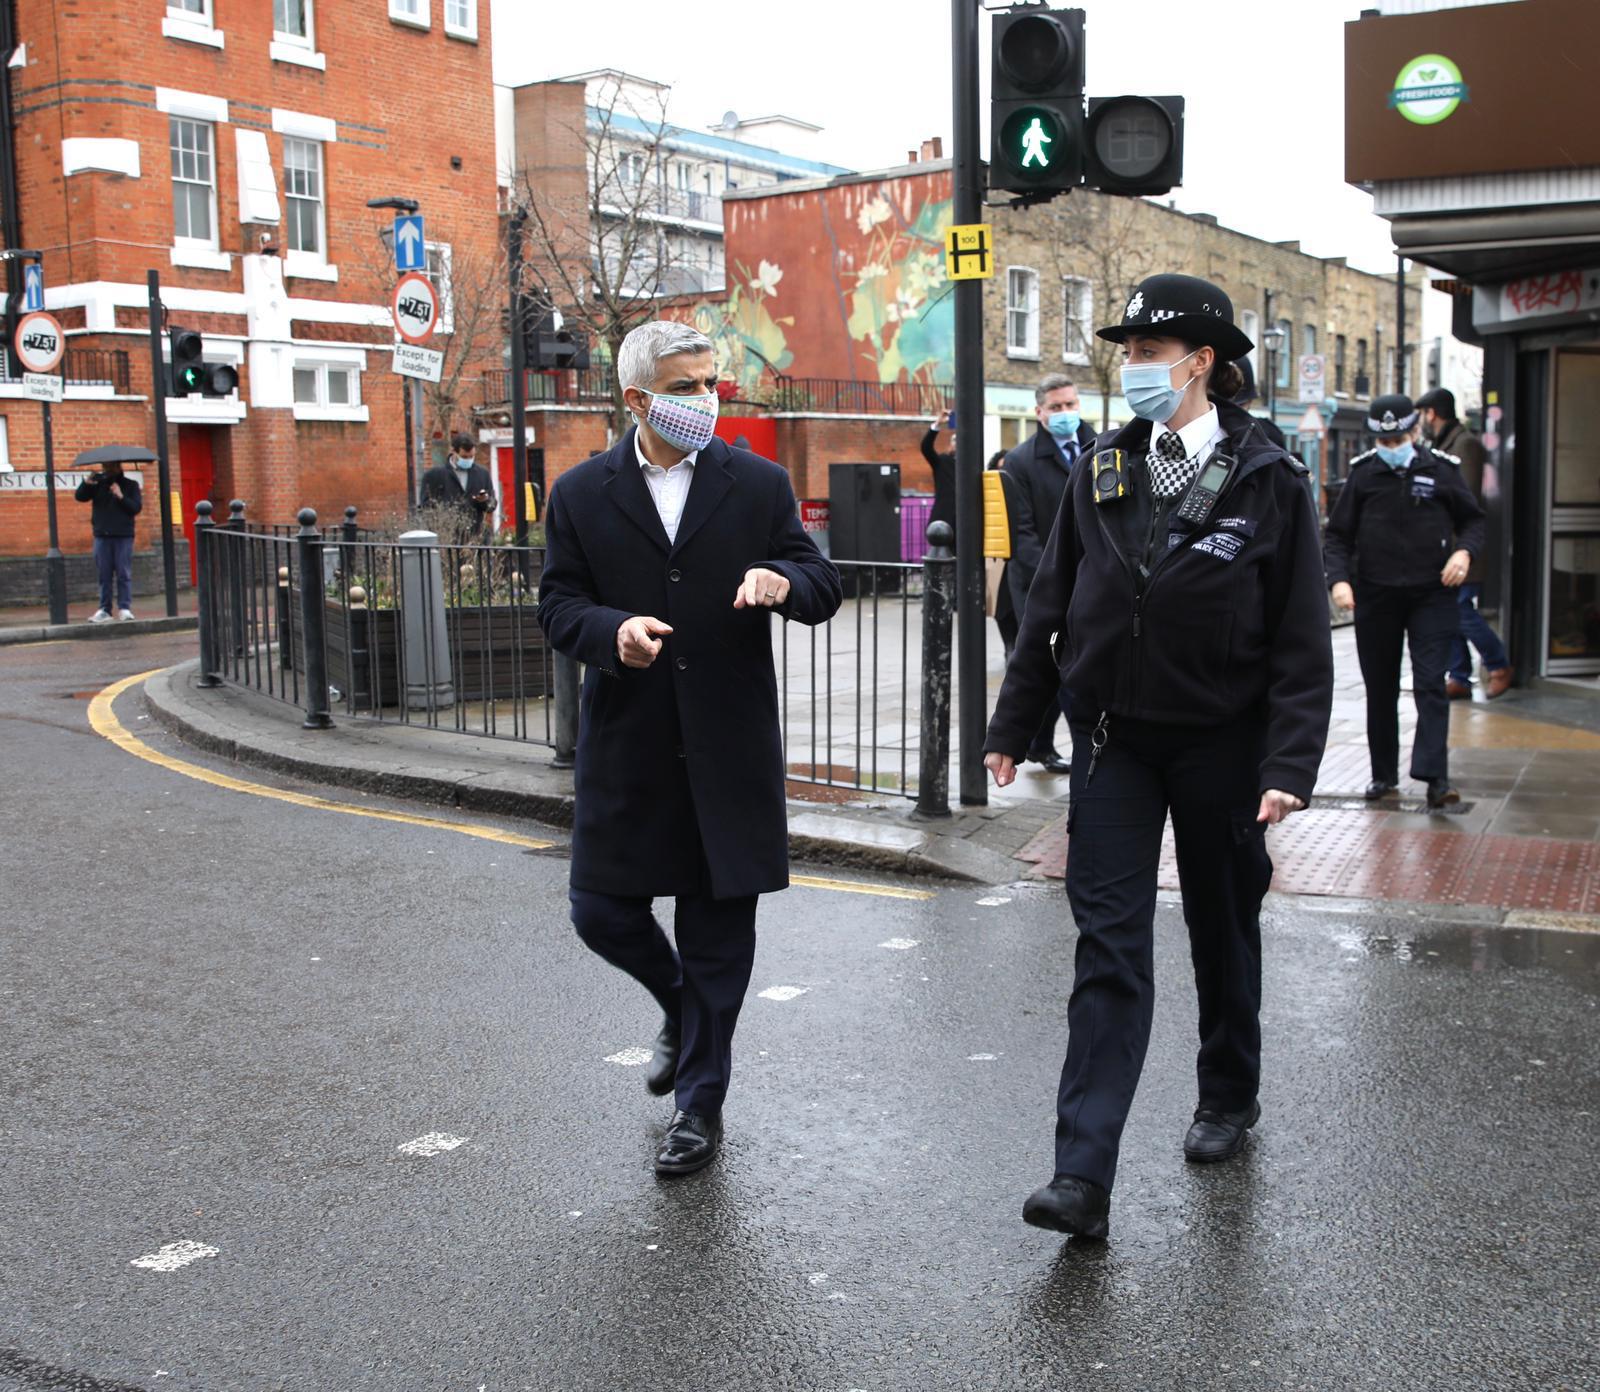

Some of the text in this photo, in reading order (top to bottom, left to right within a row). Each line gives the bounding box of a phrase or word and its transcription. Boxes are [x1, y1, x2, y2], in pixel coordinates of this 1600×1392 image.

[1400, 86, 1456, 101] FRESH FOOD
[962, 236, 976, 244] 100
[408, 299, 430, 317] 7.5T
[34, 334, 55, 348] 7.5T
[396, 346, 439, 363] Except for
[25, 374, 49, 386] Except
[1191, 543, 1214, 554] POLICE
[1216, 539, 1237, 551] POLICE
